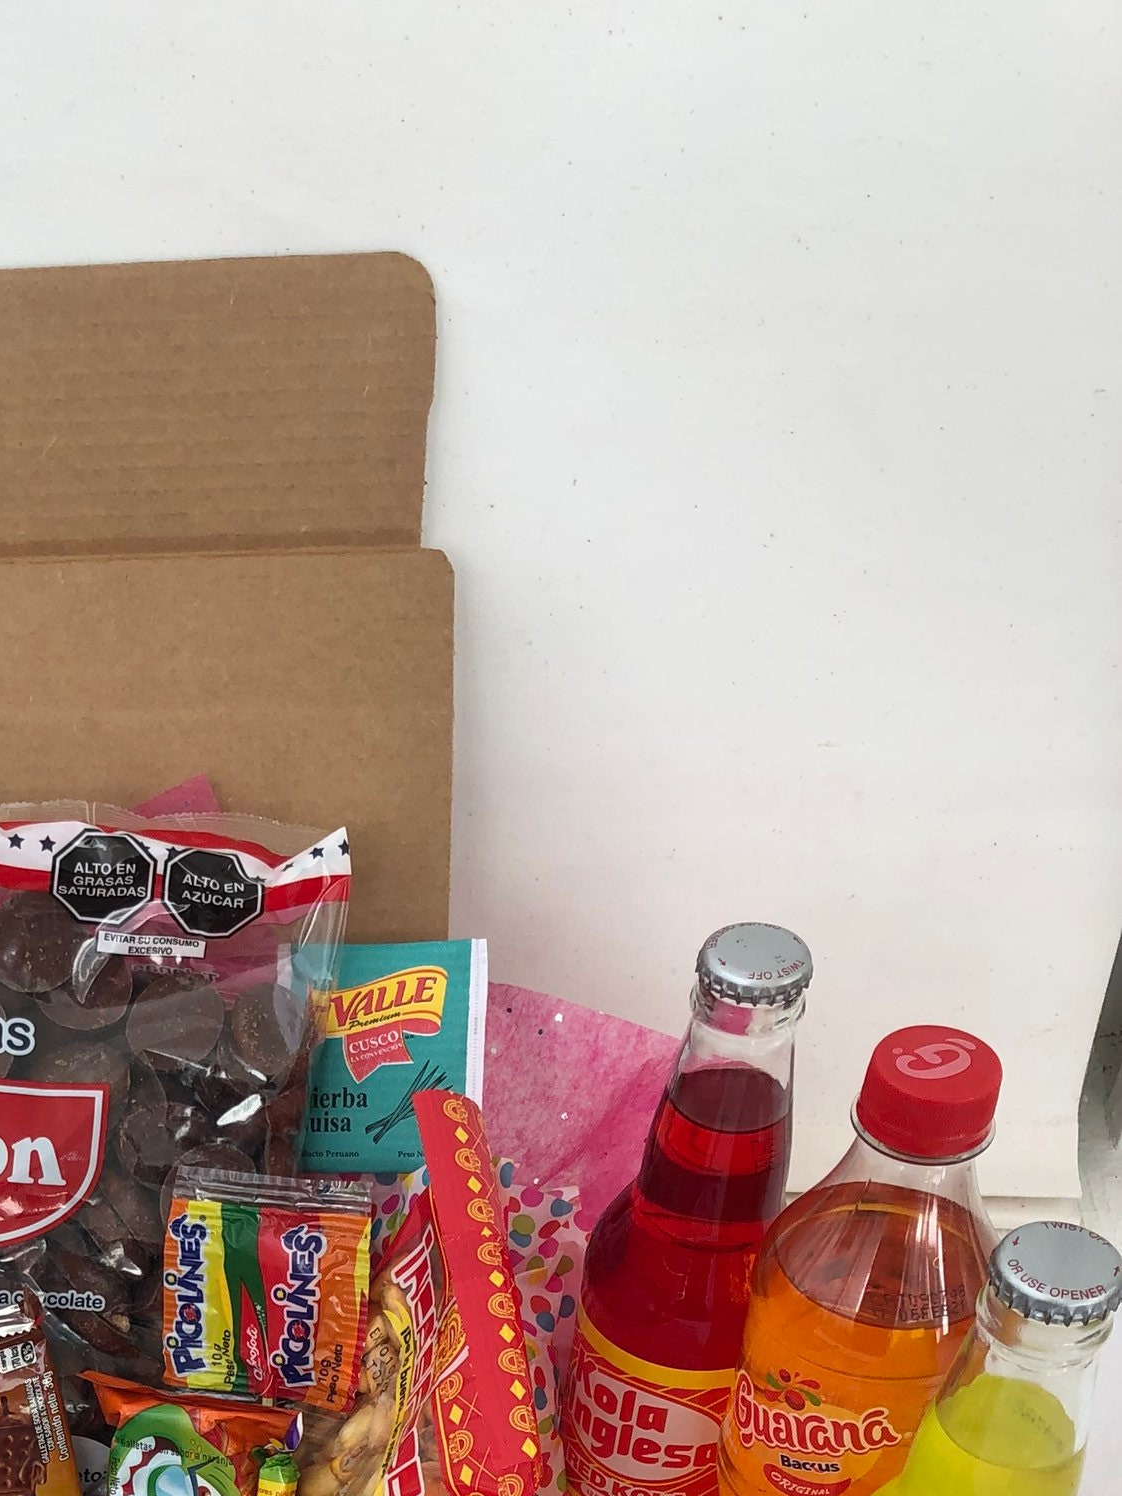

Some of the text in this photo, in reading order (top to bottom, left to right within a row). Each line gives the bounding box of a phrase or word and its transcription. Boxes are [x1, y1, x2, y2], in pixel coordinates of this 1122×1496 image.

[74, 862, 136, 875] ALTO EN
[73, 876, 133, 885] GRASAS
[182, 874, 244, 893] ALTO EN
[58, 886, 146, 898] SATURADAS
[182, 889, 244, 909] AZÚCAR
[104, 933, 199, 948] EVITAR SU CONSUMO
[128, 946, 172, 955] EXCESIVO
[748, 959, 805, 980] TWIST OFF
[330, 977, 436, 1027] VALLE
[349, 1010, 401, 1030] Premium
[349, 1030, 399, 1053] CUSCO
[360, 1042, 403, 1061] CONVENCIÓN
[326, 1150, 359, 1158] Peruano
[1043, 1222, 1084, 1232] TWIST
[1008, 1259, 1107, 1300] OR USE OPENER
[164, 1214, 211, 1377] PICOLINES
[270, 1224, 326, 1387] PICOLINES
[576, 1356, 669, 1434] Kola
[736, 1370, 899, 1453] Guaraná
[52, 1414, 69, 1461] Contenido
[567, 1451, 607, 1489] RED
[780, 1455, 840, 1472] Backus
[770, 1471, 831, 1496] ORIGINAL
